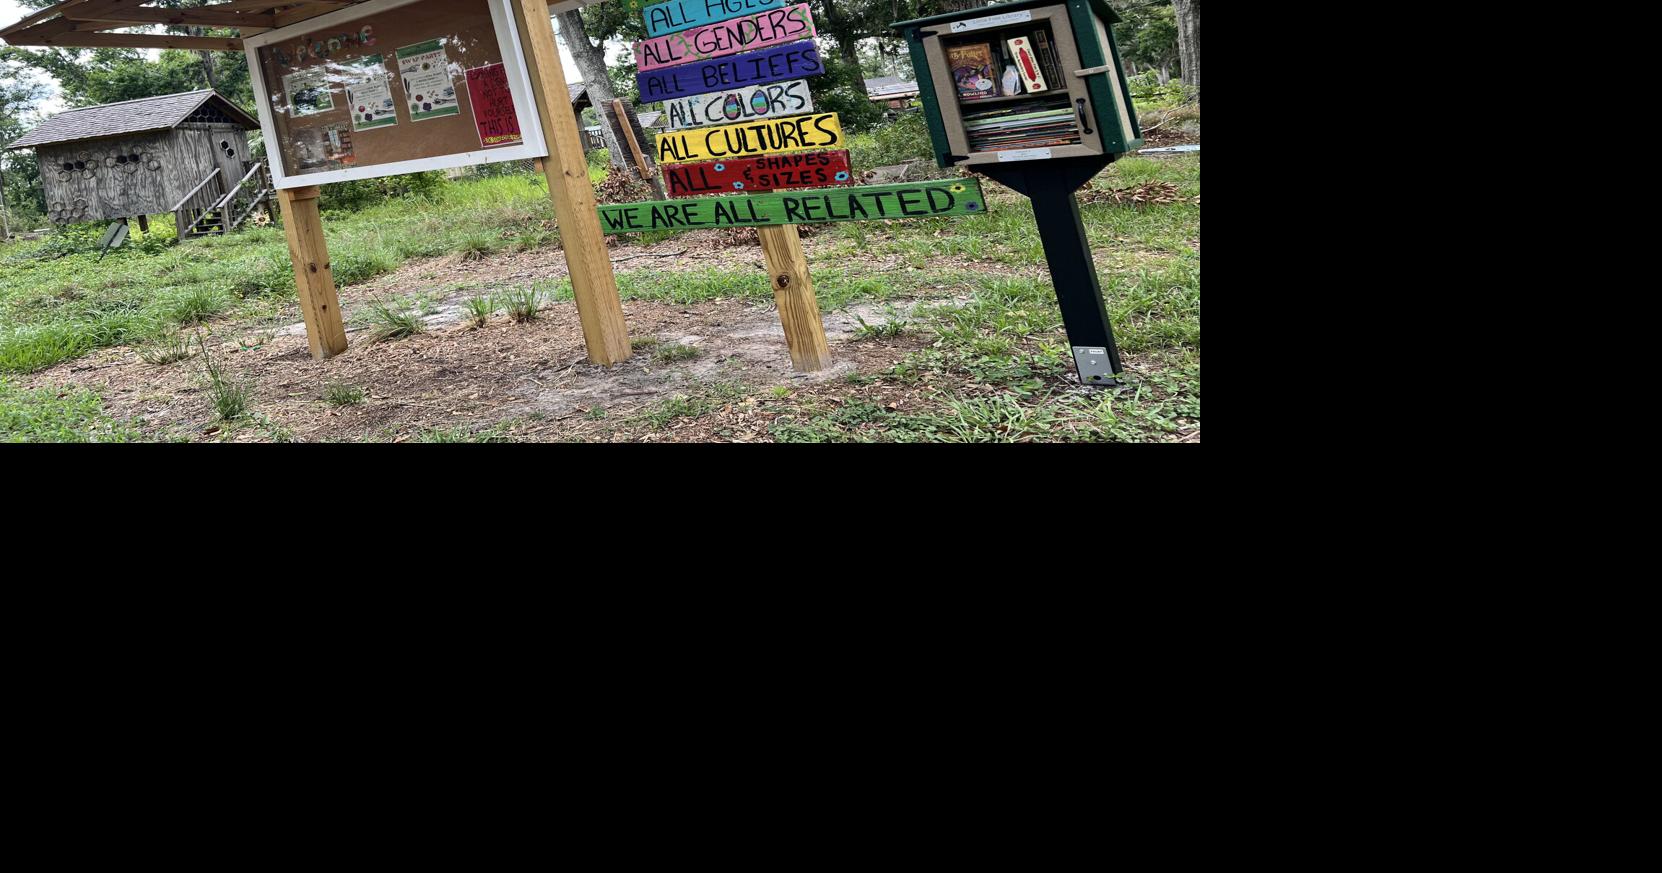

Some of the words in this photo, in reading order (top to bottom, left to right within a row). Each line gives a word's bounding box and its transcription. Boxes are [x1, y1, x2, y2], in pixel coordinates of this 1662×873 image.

[644, 40, 682, 66] ALL
[694, 7, 806, 54] GENDERS
[650, 1, 696, 33] ALL
[705, 0, 773, 17] AG
[648, 74, 685, 97] ALL
[701, 50, 820, 88] BELIEFS
[480, 118, 503, 136] THIS
[505, 116, 514, 133] IS
[670, 100, 703, 128] ALL
[705, 82, 806, 122] COLORS
[660, 135, 698, 161] ALL
[705, 115, 838, 157] CULTURES
[668, 167, 721, 194] ALL
[756, 151, 830, 170] SHAPES
[758, 170, 828, 187] SIZES
[602, 208, 643, 230] WE
[651, 203, 703, 229] ARE
[714, 199, 771, 226] ALL
[783, 187, 955, 223] RELATED
